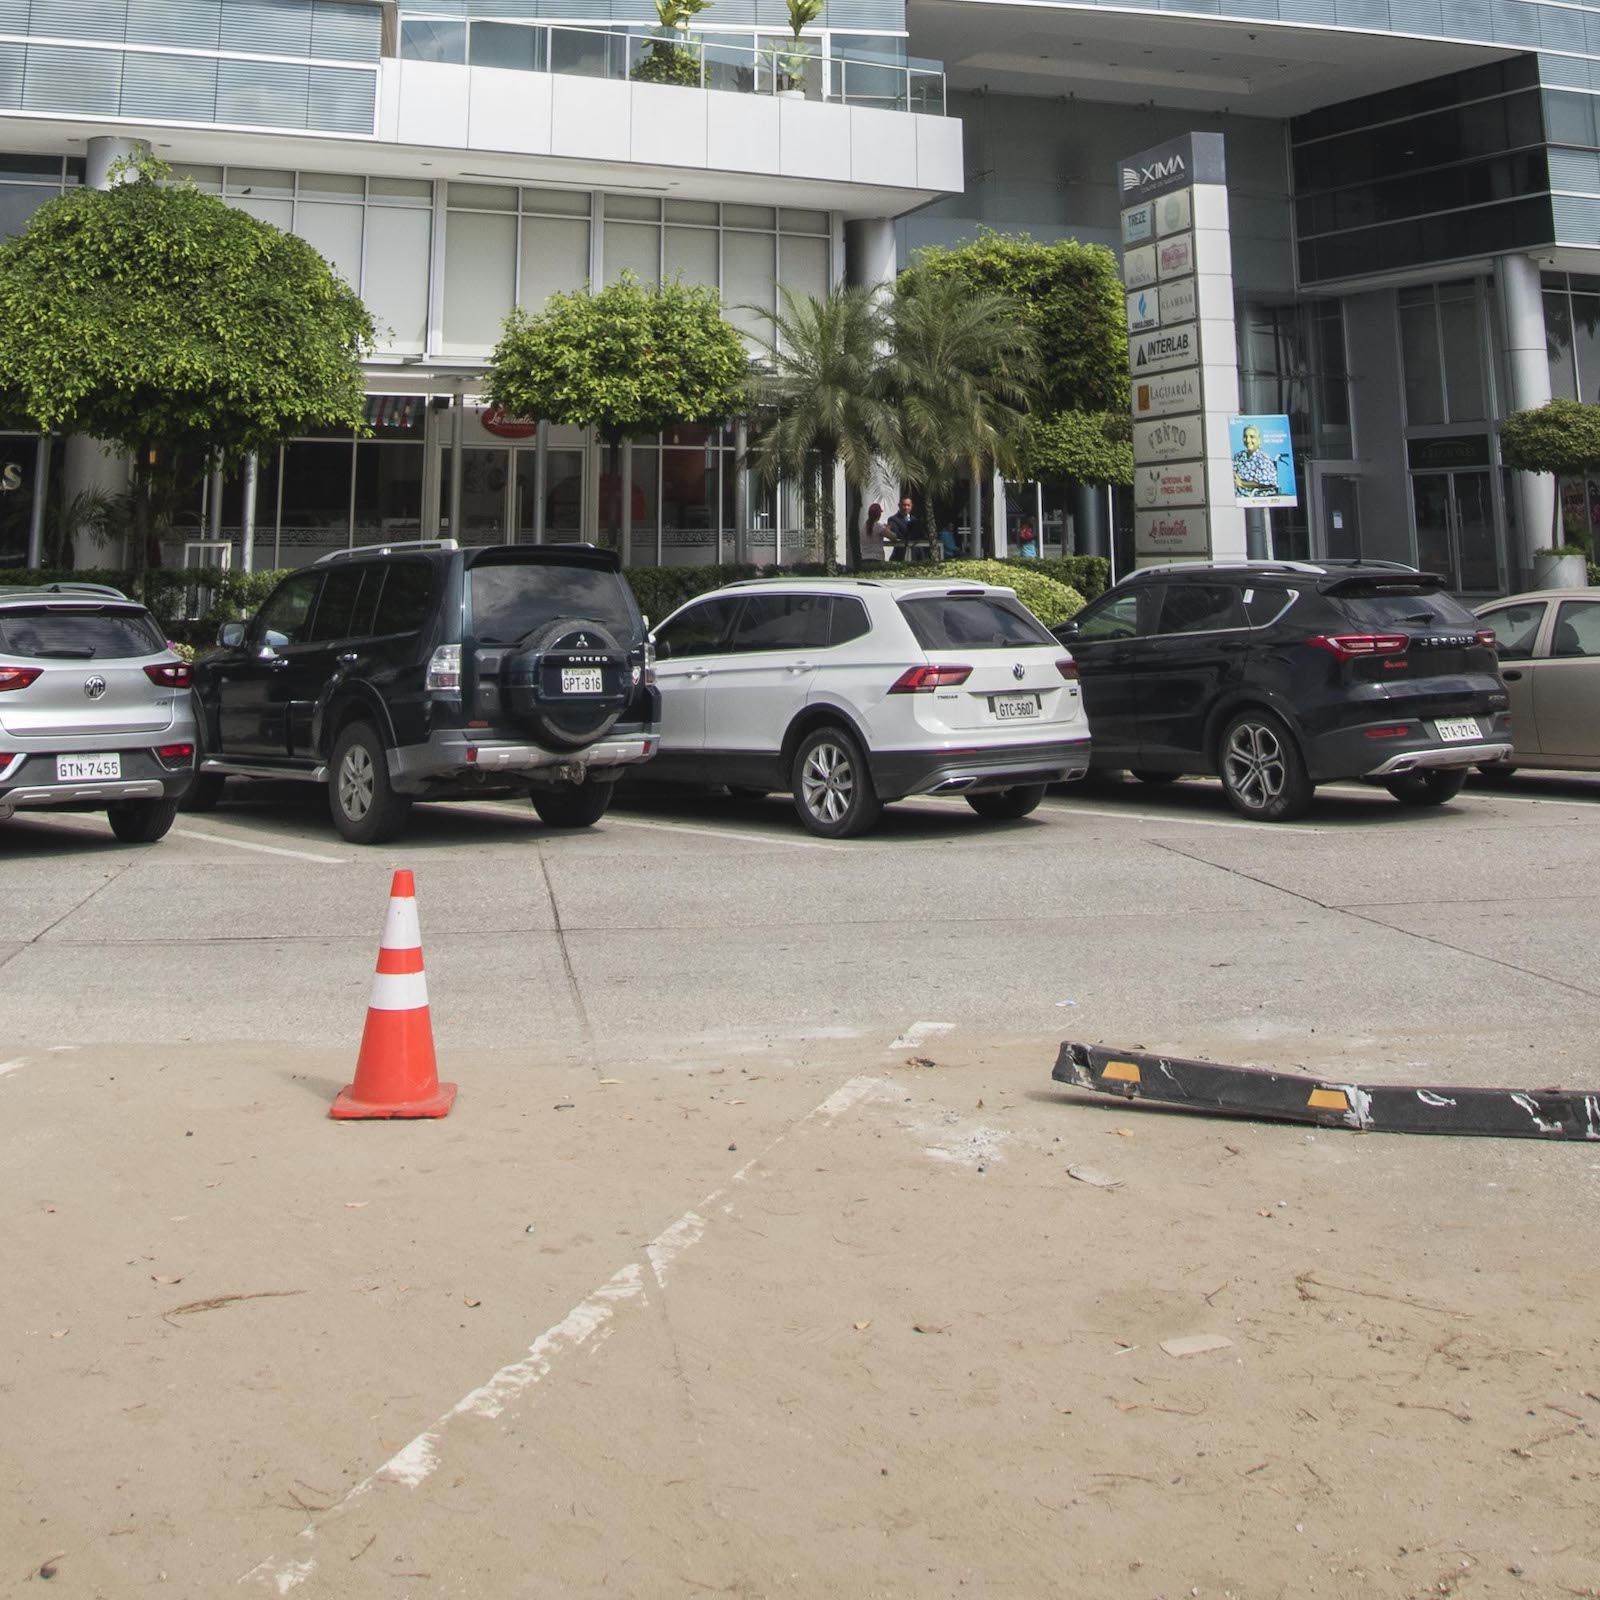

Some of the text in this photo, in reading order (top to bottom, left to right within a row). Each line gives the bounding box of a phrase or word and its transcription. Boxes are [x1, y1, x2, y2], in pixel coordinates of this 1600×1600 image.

[1141, 154, 1185, 185] XIMA
[1128, 210, 1147, 226] TREZE
[1148, 334, 1189, 356] INTERLAB
[1420, 636, 1474, 646] JETOUR
[563, 676, 601, 691] GPT-816
[1000, 702, 1034, 717] GTC-5607
[1440, 724, 1480, 739] GTA-2743
[59, 761, 119, 778] GTN-7455
